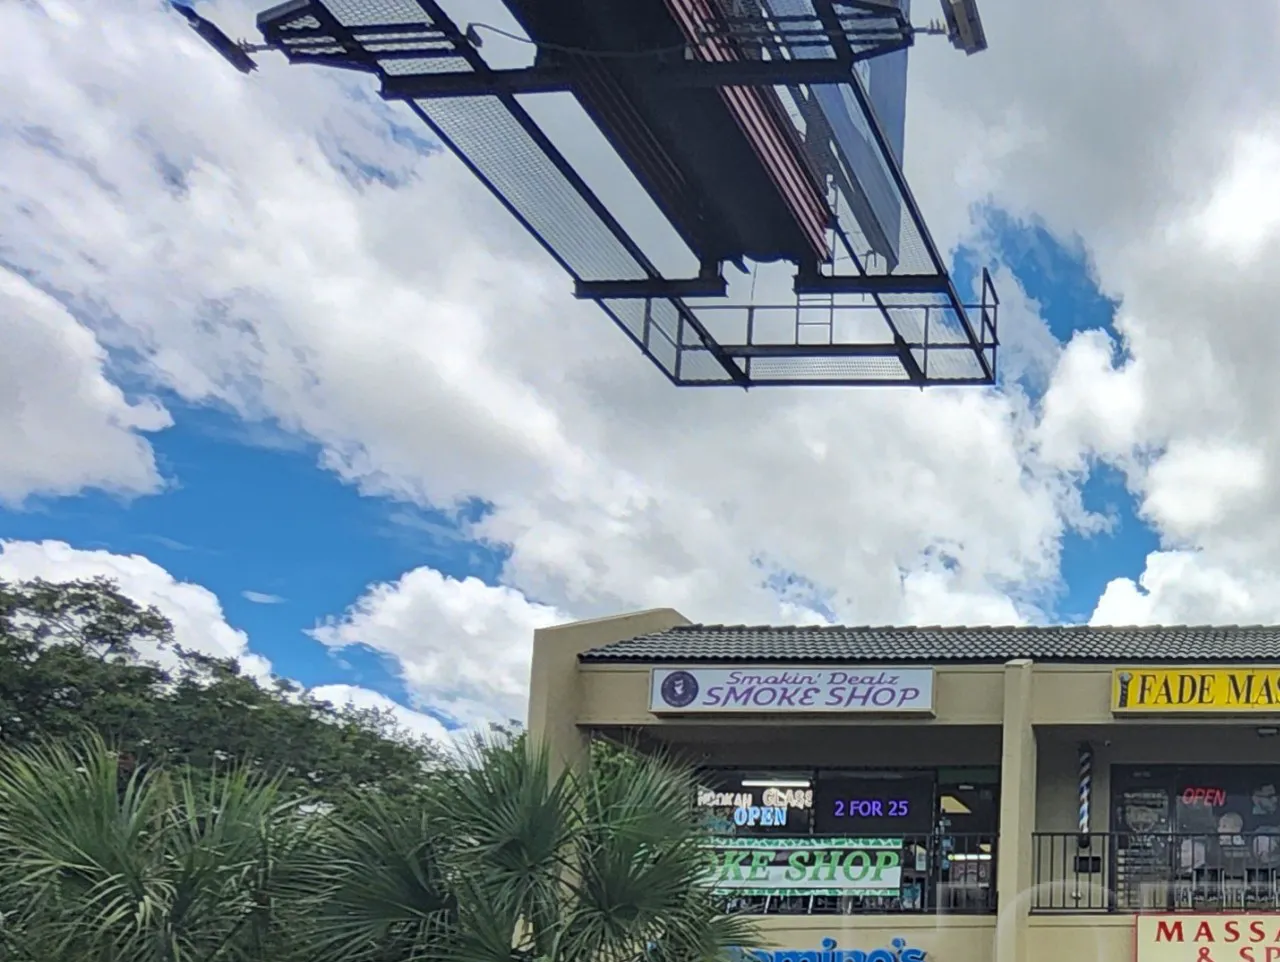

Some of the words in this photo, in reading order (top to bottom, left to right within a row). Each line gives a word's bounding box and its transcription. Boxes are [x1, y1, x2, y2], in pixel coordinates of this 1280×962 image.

[725, 671, 822, 686] Smokin'
[827, 672, 900, 686] Dealz
[702, 686, 821, 708] SMOKE
[824, 686, 921, 708] SHOP
[1136, 674, 1215, 704] FADE
[762, 789, 814, 809] GLASS
[1182, 787, 1225, 806] OPEN
[734, 807, 787, 826] OPEN
[834, 801, 845, 816] 2
[851, 801, 883, 816] FOR
[888, 801, 908, 816] 25
[785, 851, 899, 882] SHOP
